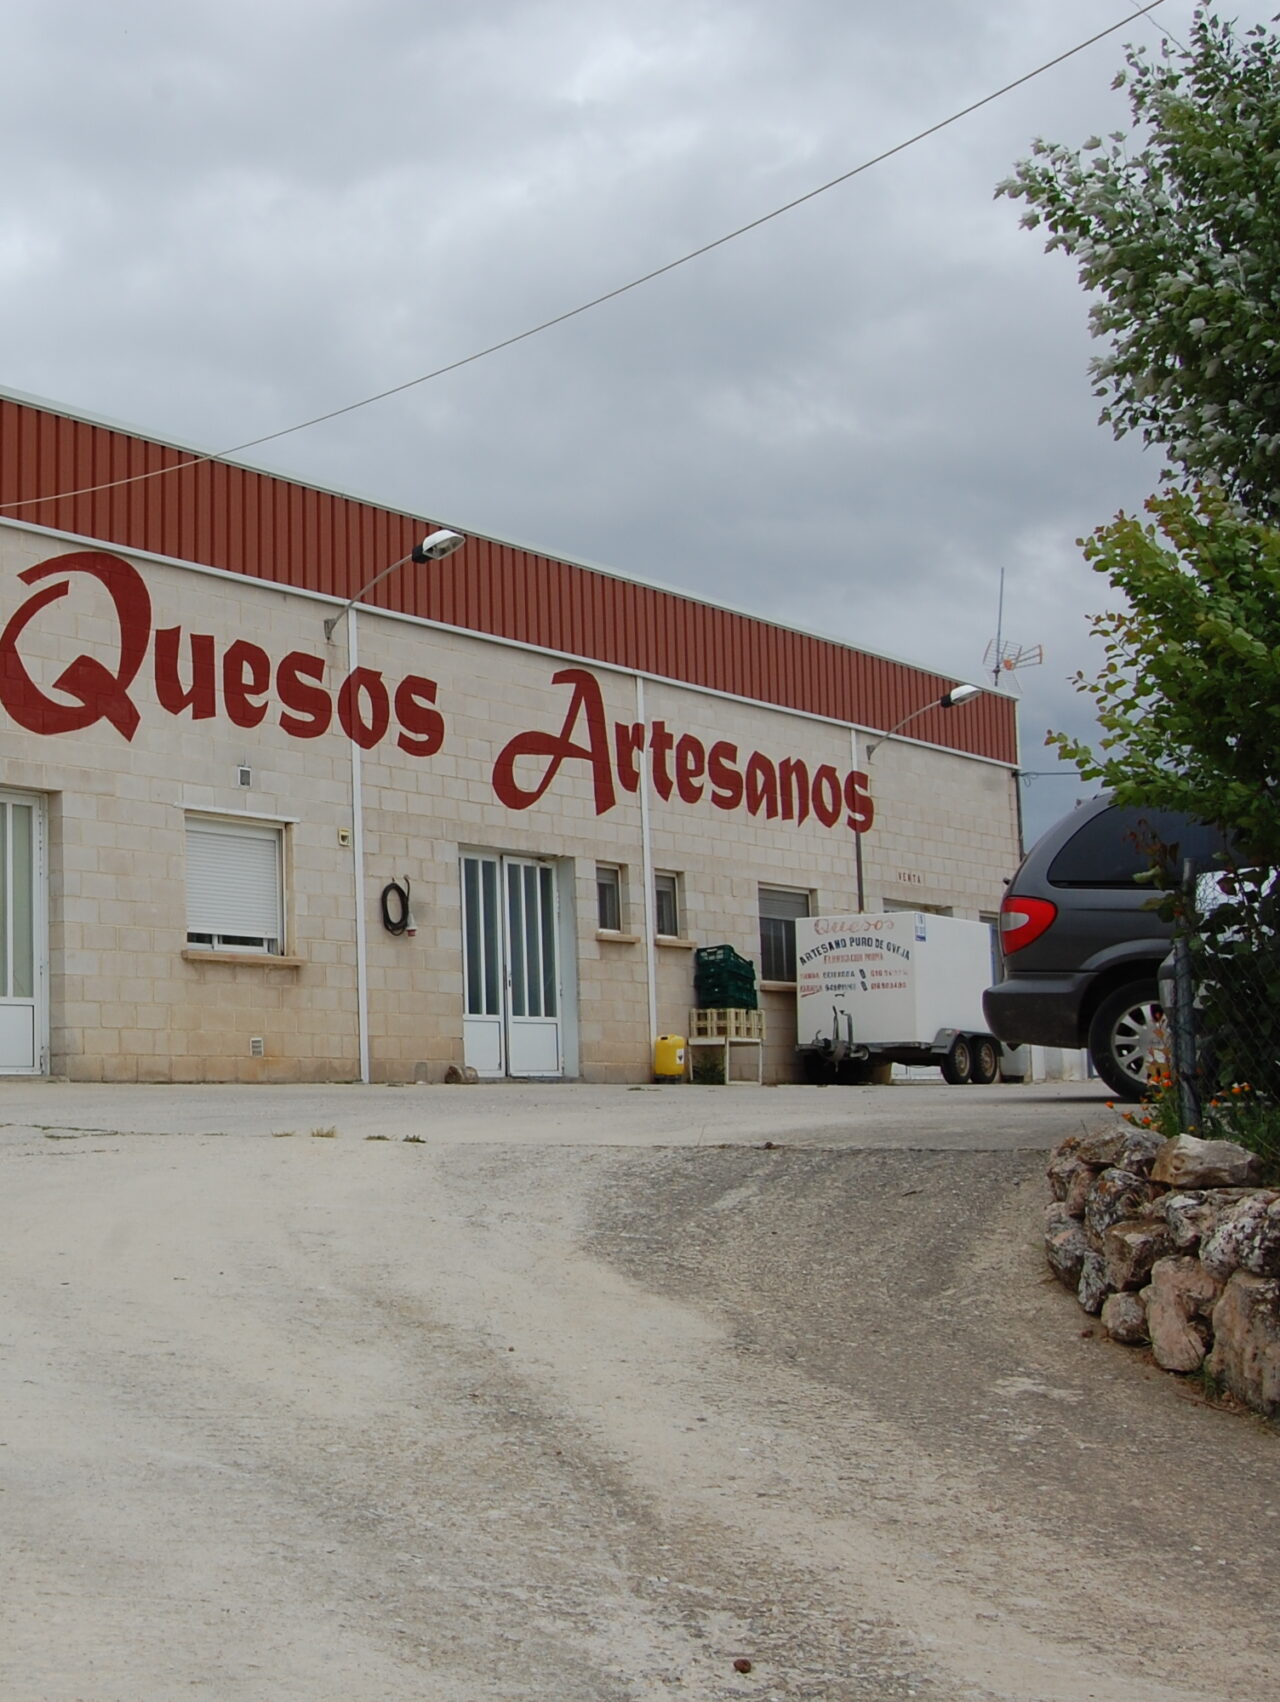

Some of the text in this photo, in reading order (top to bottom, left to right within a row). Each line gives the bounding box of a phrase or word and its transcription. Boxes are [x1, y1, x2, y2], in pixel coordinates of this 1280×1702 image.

[492, 668, 874, 833] Artesanos
[898, 872, 921, 884] VENTA
[800, 938, 847, 966] ARTESANO
[849, 937, 873, 947] PURO
[875, 939, 884, 949] DE
